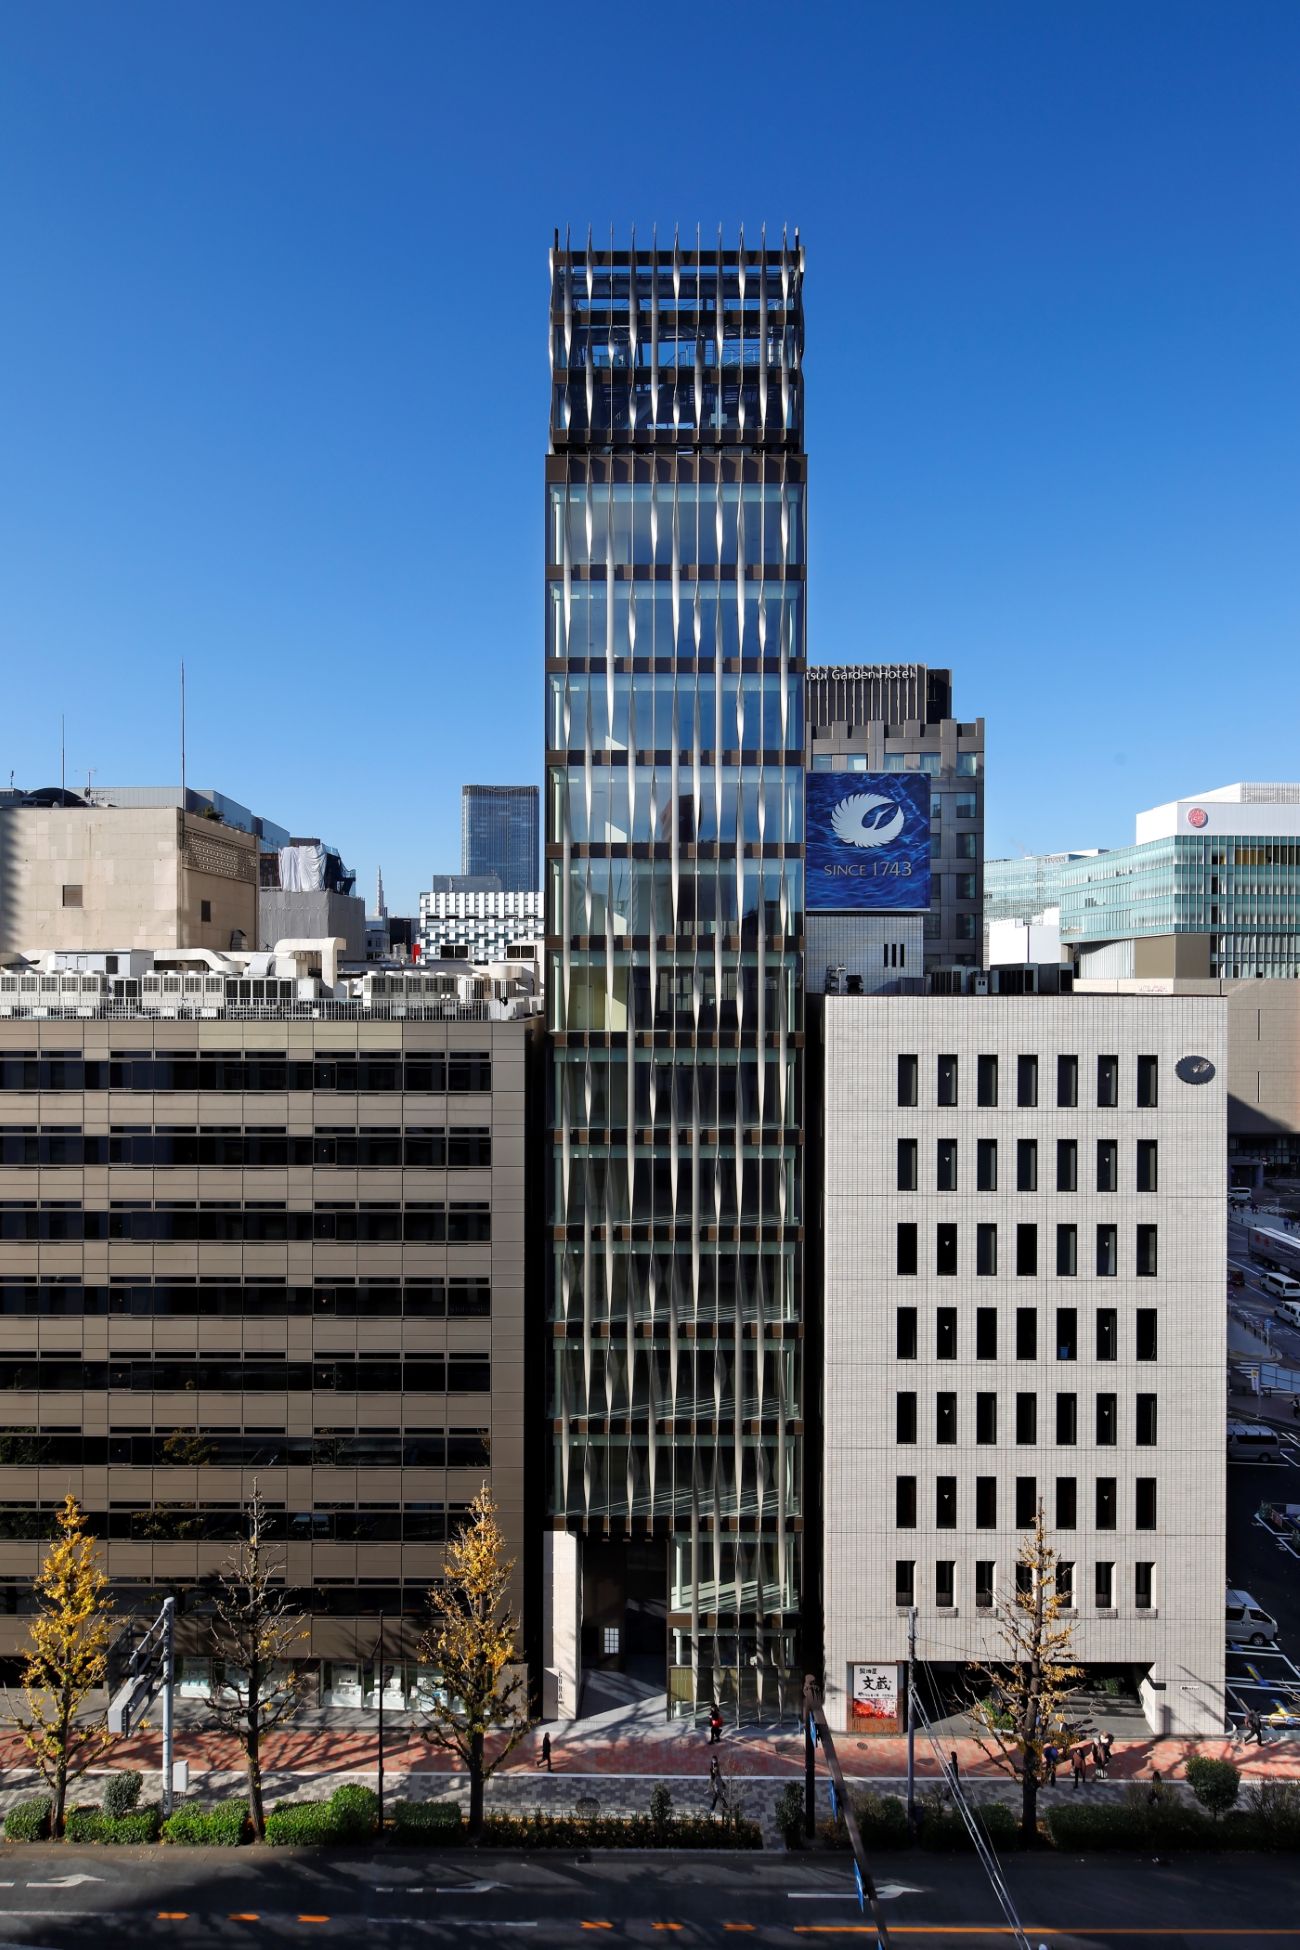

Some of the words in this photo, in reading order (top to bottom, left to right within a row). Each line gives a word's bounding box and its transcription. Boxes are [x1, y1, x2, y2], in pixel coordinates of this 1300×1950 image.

[831, 669, 876, 680] Garden
[879, 667, 914, 679] Hotel
[824, 864, 867, 876] SINCE
[872, 861, 912, 876] 1743
[862, 1675, 892, 1690] 文蔵
